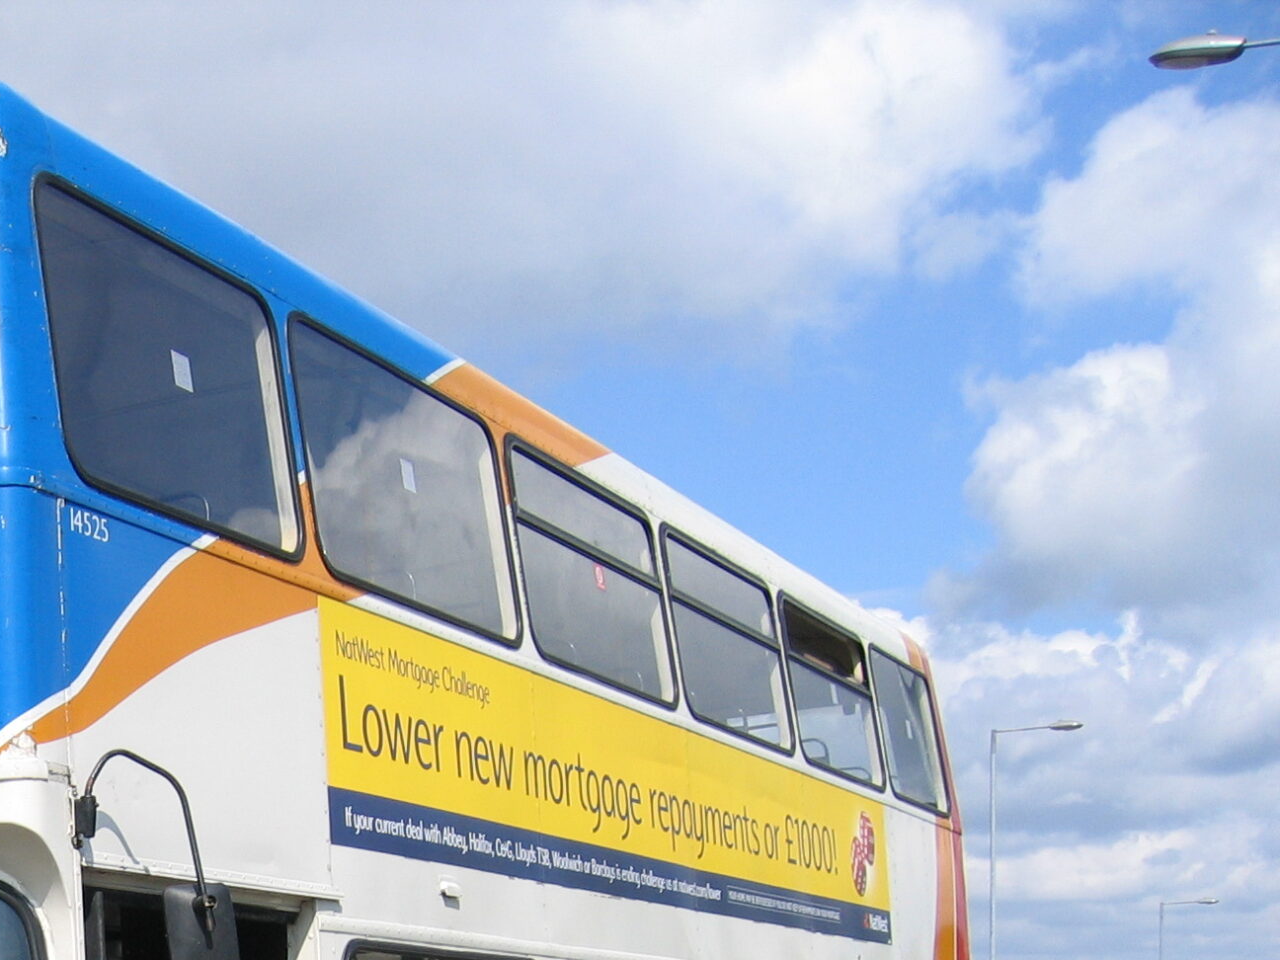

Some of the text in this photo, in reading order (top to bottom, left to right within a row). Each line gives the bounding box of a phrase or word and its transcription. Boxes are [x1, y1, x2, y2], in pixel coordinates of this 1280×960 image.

[70, 507, 109, 542] 14525
[335, 629, 490, 709] NatWest Mortgage Challenge
[338, 674, 839, 876] Lower new mortgage repayments or £1000!
[344, 806, 353, 827] If
[353, 814, 374, 835] your
[375, 818, 405, 838] current
[406, 818, 423, 840] deal
[424, 823, 442, 844] with
[443, 826, 468, 855] Abbey,
[469, 832, 495, 858] Halifax,
[515, 842, 536, 867] Lloyds
[536, 846, 552, 869] TSB,
[552, 850, 584, 873] Woolwich
